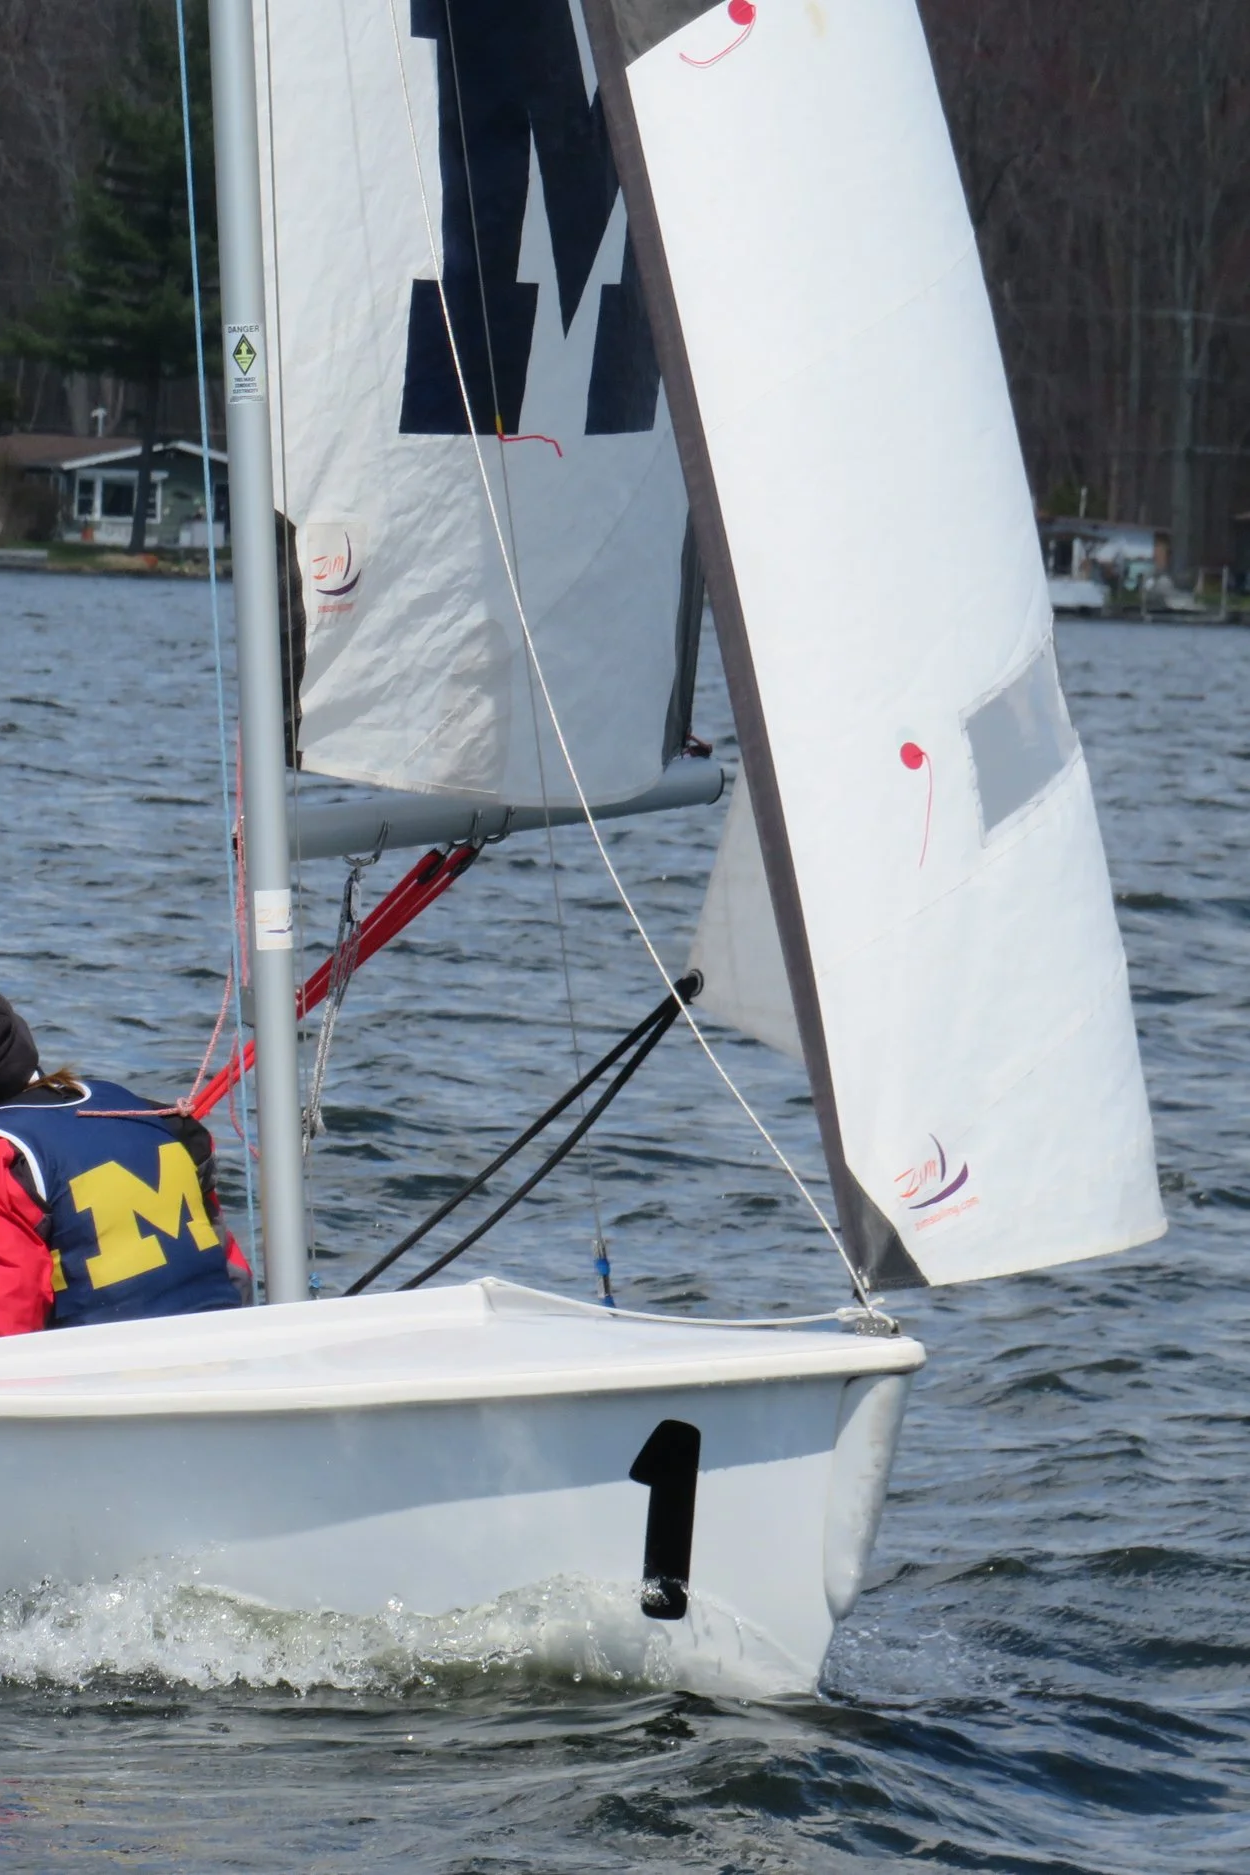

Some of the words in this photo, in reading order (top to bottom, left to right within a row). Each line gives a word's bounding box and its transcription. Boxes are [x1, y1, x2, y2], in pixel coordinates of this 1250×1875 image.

[399, 0, 661, 436] M
[228, 325, 260, 334] DANGER
[69, 1142, 220, 1290] M
[629, 1419, 701, 1620] 1
